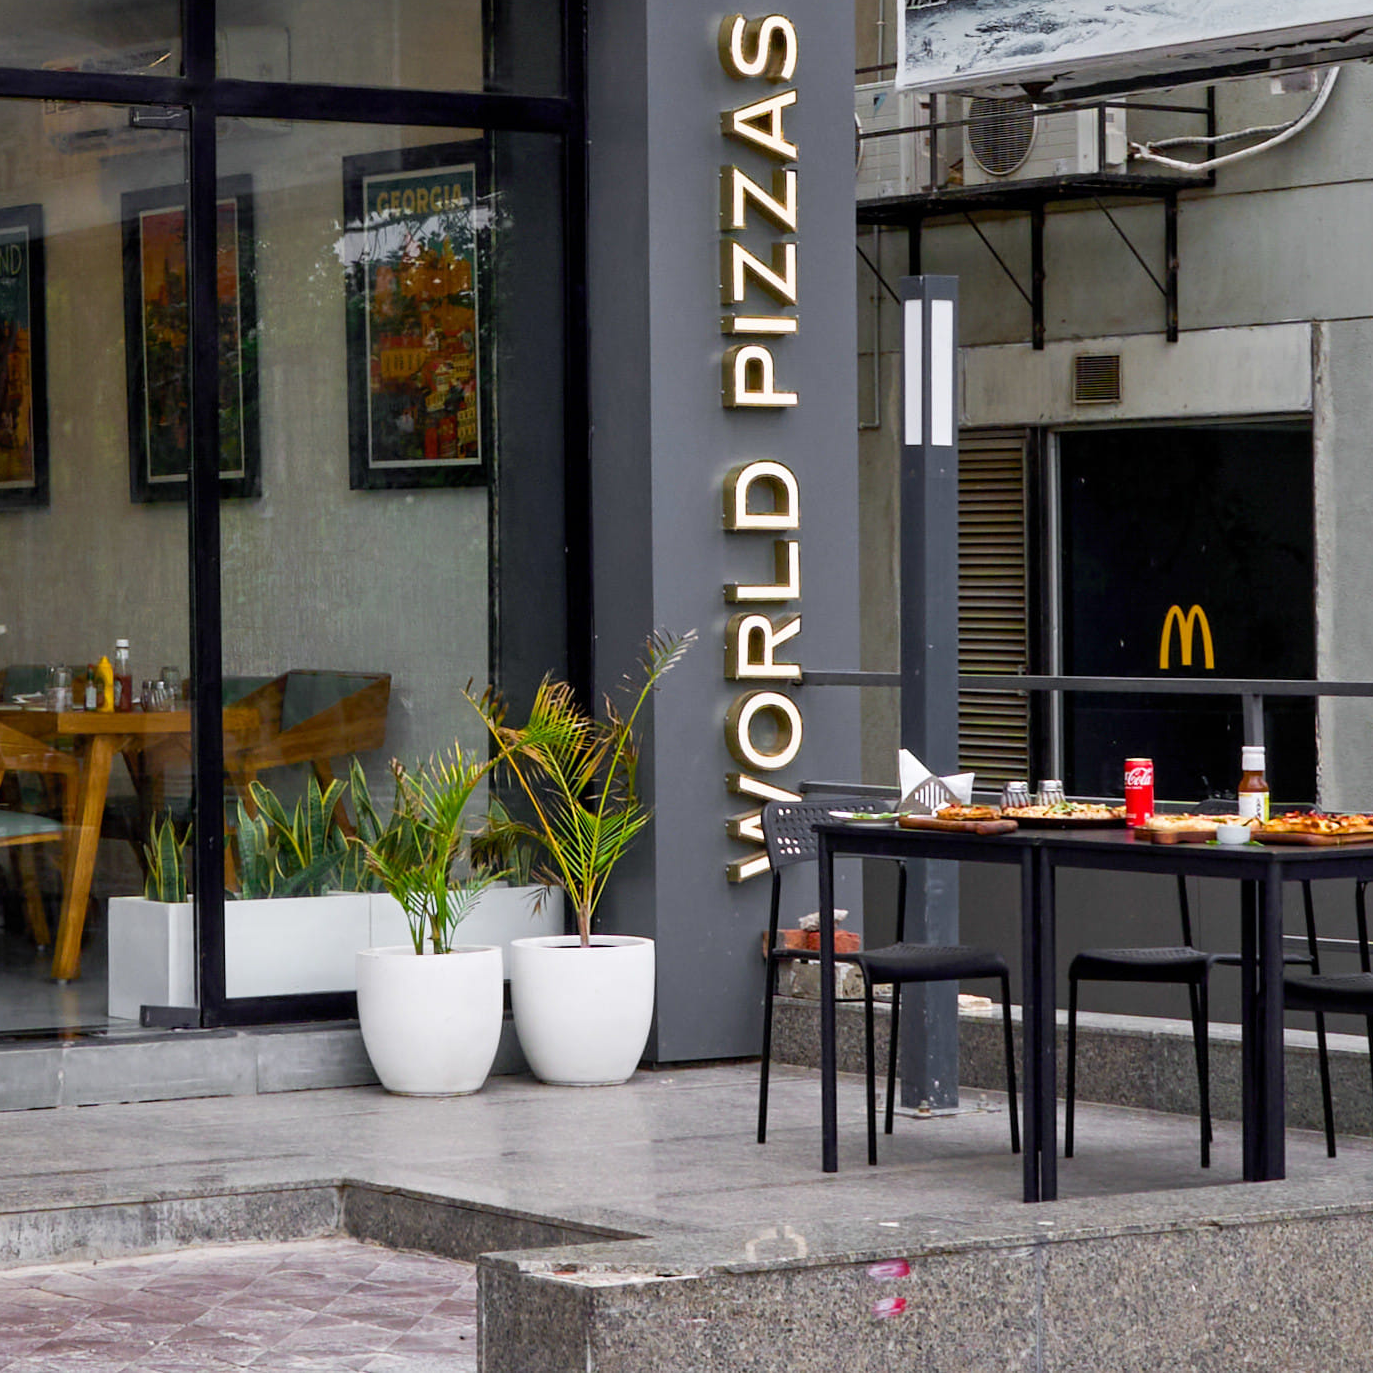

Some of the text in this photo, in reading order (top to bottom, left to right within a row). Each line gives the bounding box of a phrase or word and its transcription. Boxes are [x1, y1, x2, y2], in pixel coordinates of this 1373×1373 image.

[375, 183, 465, 216] GEORGIA
[718, 13, 804, 883] WORLD PIZZAS
